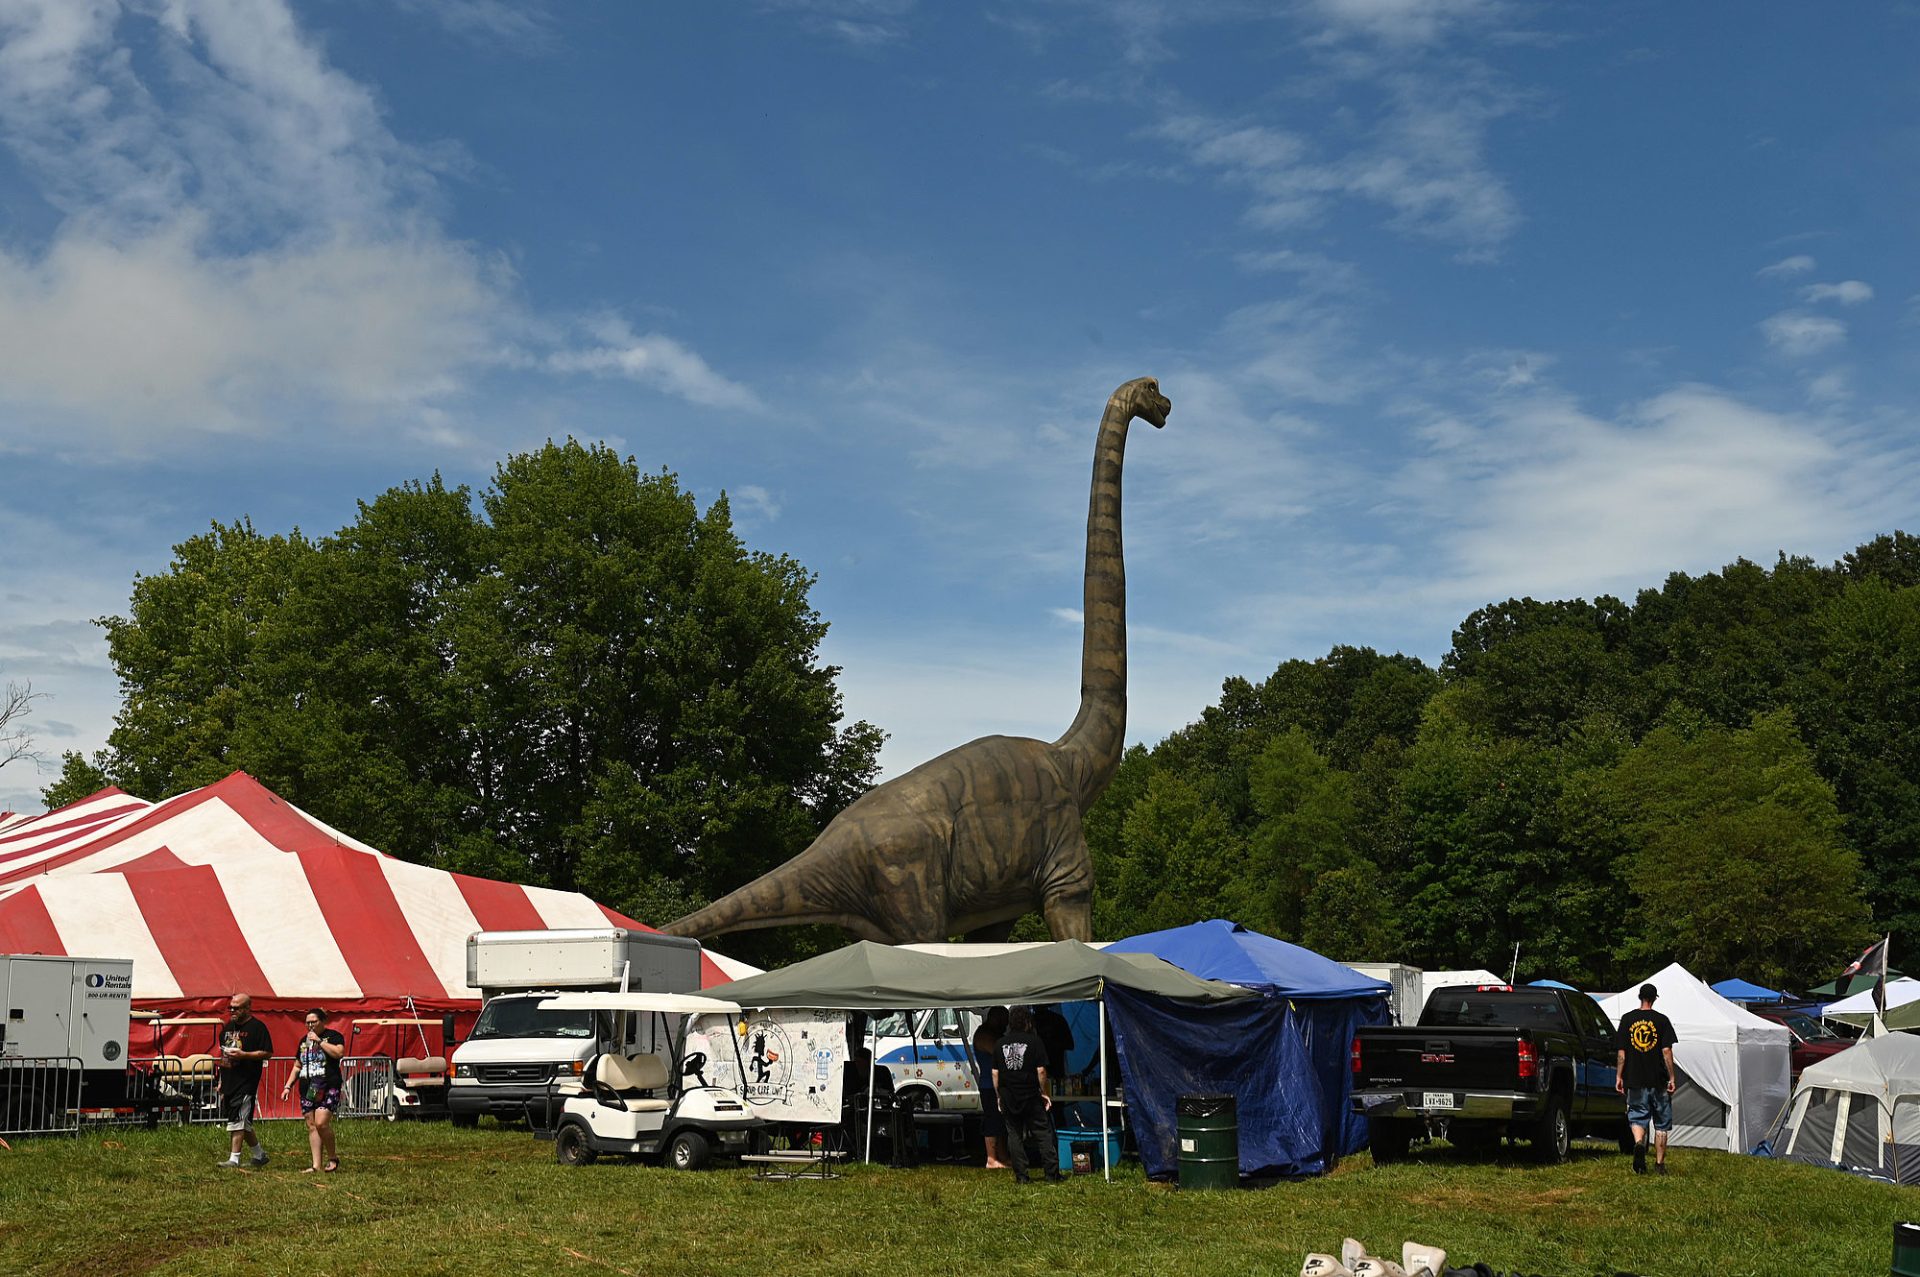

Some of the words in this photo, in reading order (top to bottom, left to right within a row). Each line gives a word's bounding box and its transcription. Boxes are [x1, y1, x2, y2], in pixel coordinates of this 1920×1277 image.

[105, 974, 130, 982] United
[105, 981, 132, 989] Rentals
[1421, 1053, 1455, 1063] GMC
